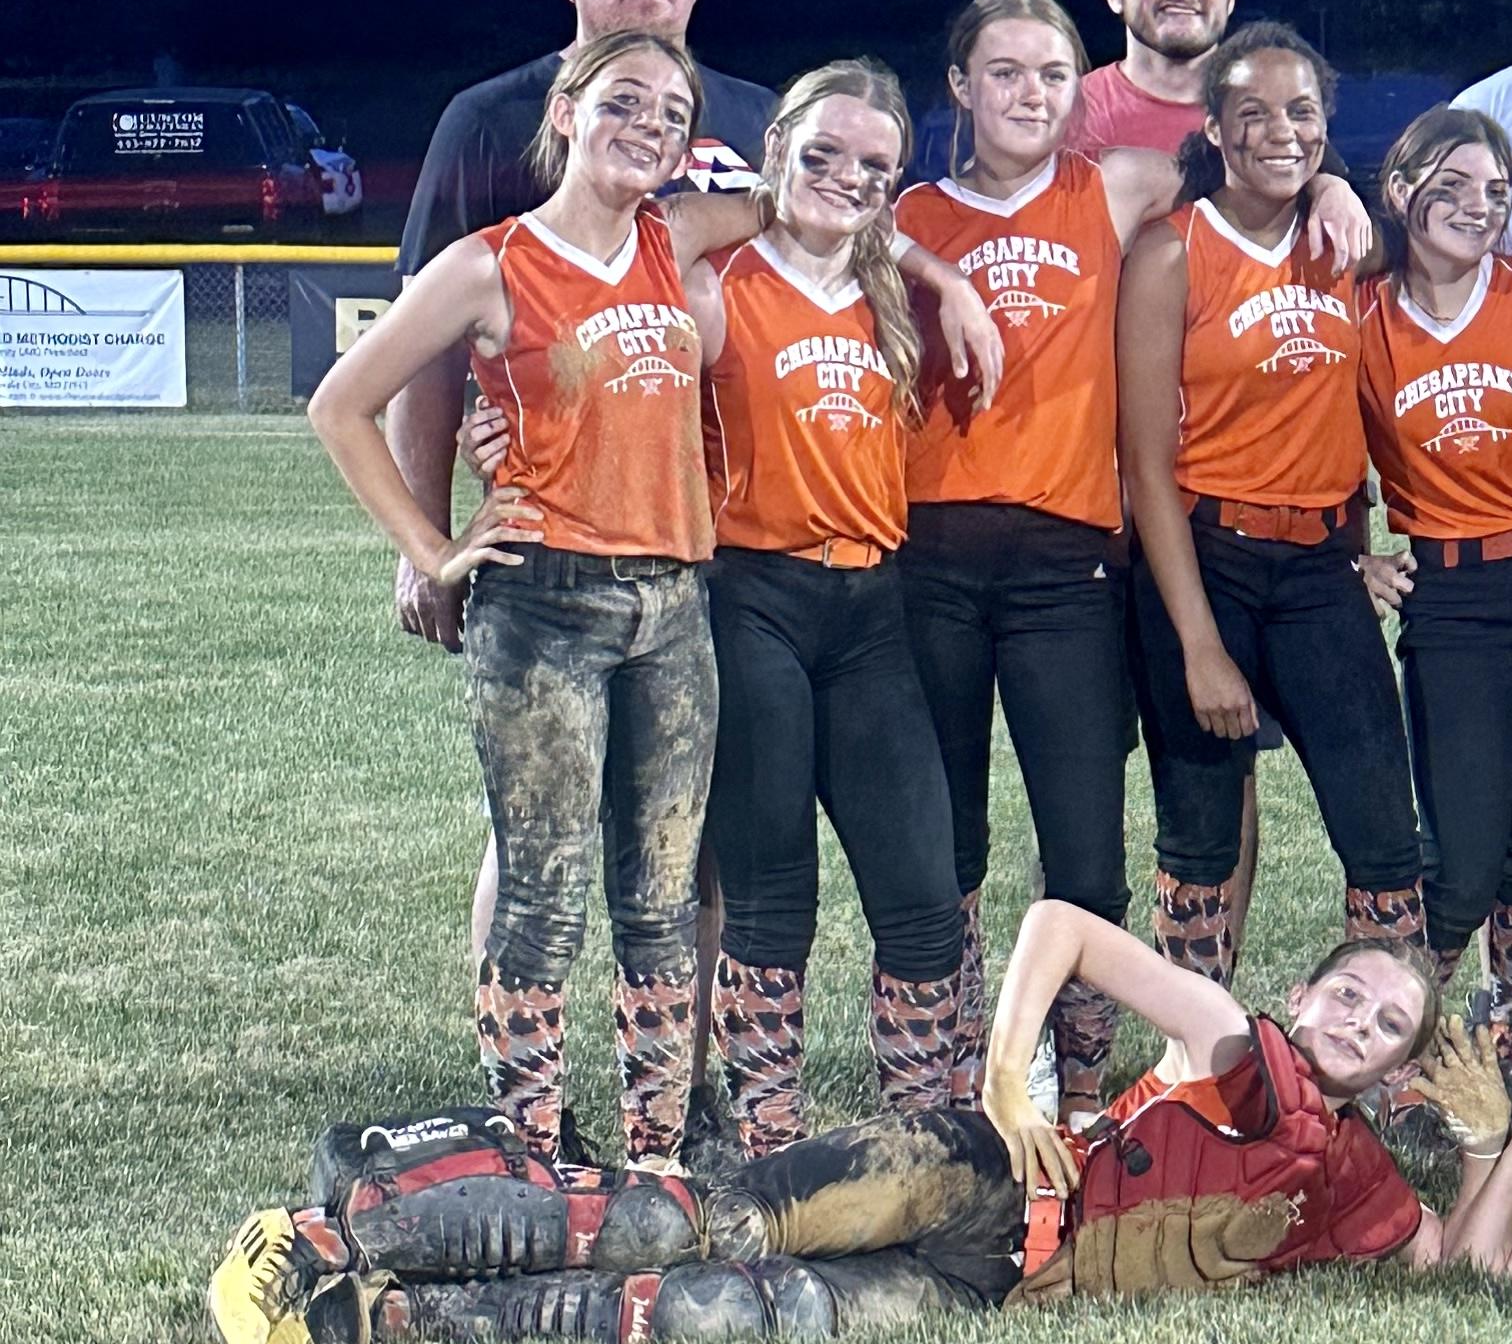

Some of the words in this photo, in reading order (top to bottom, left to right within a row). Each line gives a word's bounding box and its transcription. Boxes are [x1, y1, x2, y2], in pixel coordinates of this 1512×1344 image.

[957, 235, 1081, 277] HESAPEAKE
[987, 262, 1040, 291] CITY
[1269, 310, 1316, 339] CITY
[616, 327, 667, 357] CITY
[774, 335, 898, 380] CHESAPEAK
[815, 361, 864, 393] CITY
[1434, 388, 1485, 420] CITY
